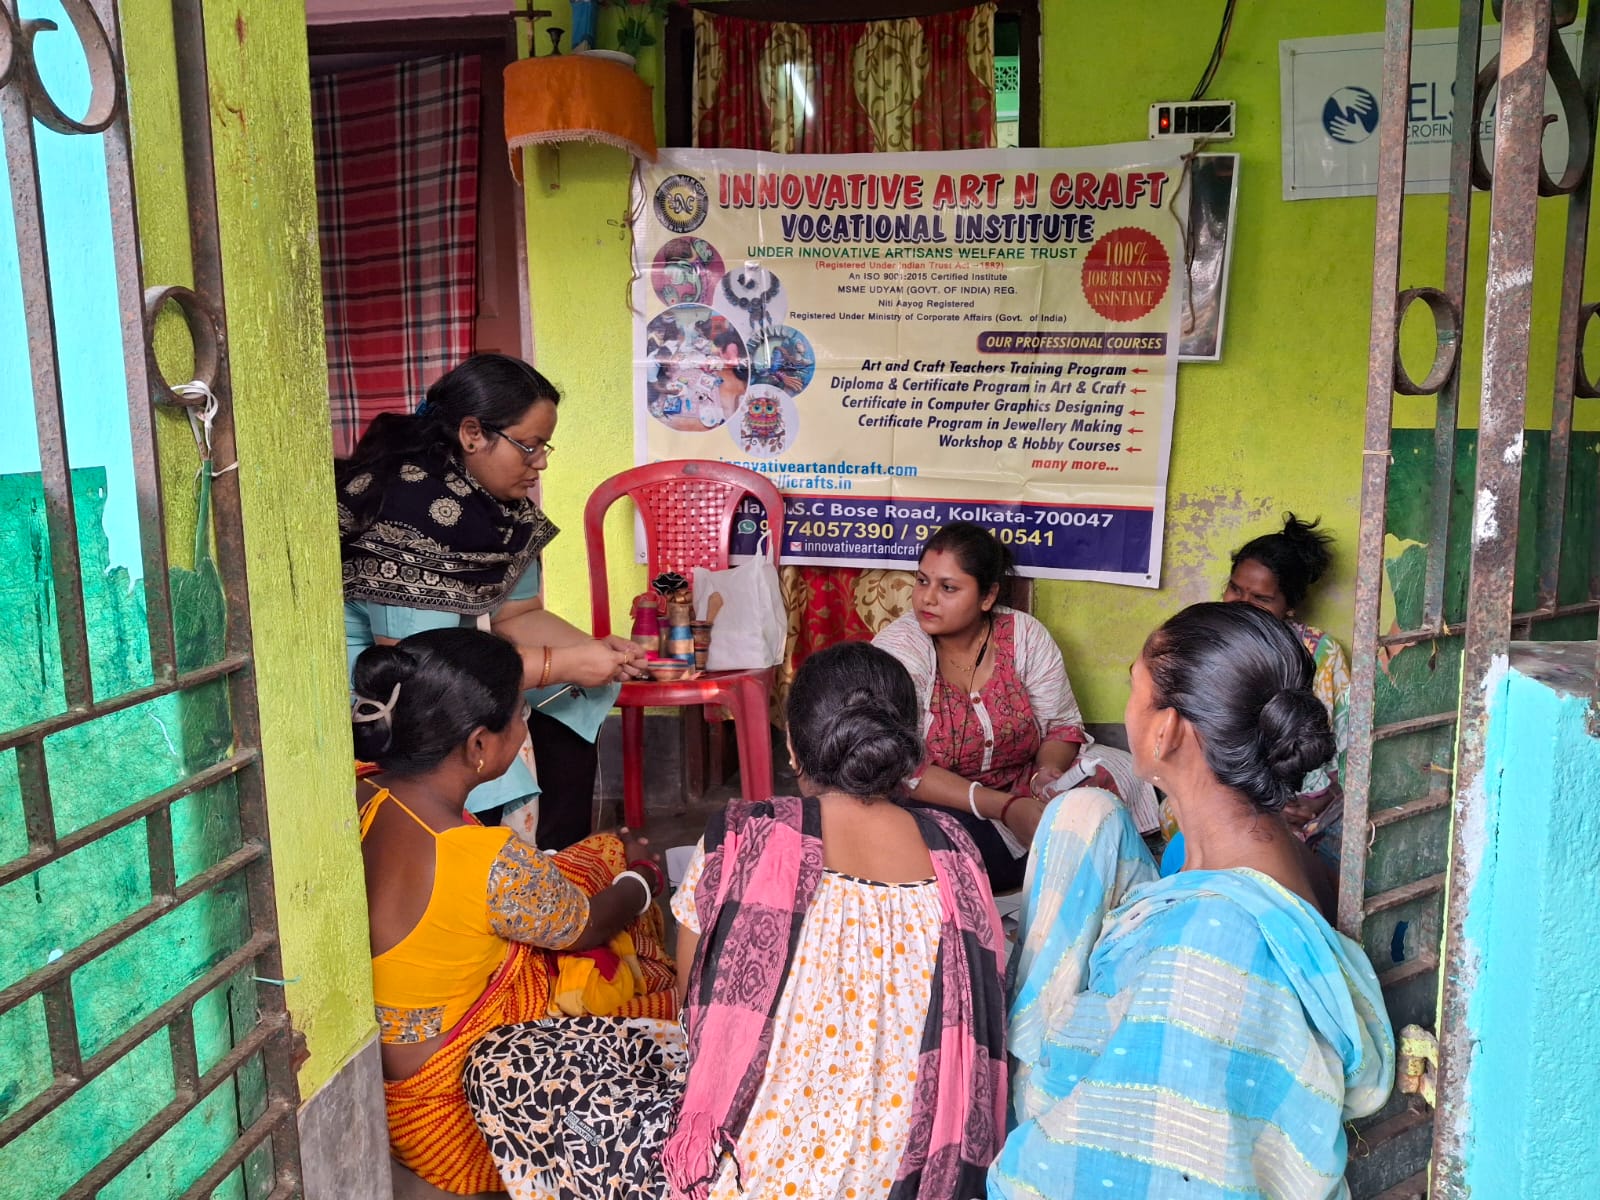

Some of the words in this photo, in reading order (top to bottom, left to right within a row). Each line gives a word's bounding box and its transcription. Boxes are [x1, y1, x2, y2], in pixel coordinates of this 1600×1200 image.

[718, 172, 924, 210] INNOVATIVE
[932, 172, 1004, 209] ART
[1013, 172, 1038, 209] N
[1049, 171, 1169, 210] CRAFT
[781, 213, 947, 244] VOCATIONAL
[954, 212, 1095, 244] INSTITUTE
[747, 246, 793, 258] UNDER
[799, 247, 880, 258] INNOVATIVE
[884, 247, 953, 259] ARTISANS
[958, 247, 1025, 259] WELFARE
[1030, 247, 1078, 259] TRUST
[1103, 241, 1150, 267] 100%
[815, 260, 866, 270] (Registered
[869, 261, 896, 269] Under
[849, 272, 860, 280] An
[863, 272, 880, 280] ISO
[930, 272, 969, 281] Certified
[971, 272, 1008, 281] Institute
[1087, 270, 1163, 288] JOB/BUSINESS
[869, 286, 904, 294] UDYAM
[906, 286, 941, 295] (GOVT.
[943, 286, 957, 294] OF
[960, 286, 991, 296] INDIA)
[993, 286, 1018, 295] REG.
[1094, 290, 1154, 306] ASSISTANCE
[896, 300, 923, 309] Aayog
[926, 300, 975, 309] Registered
[789, 311, 836, 320] Registered
[838, 312, 865, 320] Under
[868, 312, 901, 322] Ministry
[904, 313, 914, 321] of
[916, 313, 960, 322] Corporate
[963, 313, 993, 321] Affairs
[995, 313, 1023, 323] (Govt.
[1029, 313, 1038, 321] of
[1041, 313, 1067, 323] India)
[986, 335, 1013, 348] OUR
[1015, 336, 1103, 349] PROFESSIONAL
[1106, 337, 1163, 350] COURSES
[861, 359, 882, 372] Art
[885, 359, 910, 372] and
[913, 360, 945, 373] Craft
[949, 360, 1005, 373] Teachers
[1010, 361, 1063, 377] Training
[1067, 361, 1127, 377] Program
[831, 376, 884, 392] Diploma
[888, 377, 898, 390] &
[902, 377, 969, 392] Certificate
[973, 379, 1030, 395] Program
[1034, 380, 1046, 393] in
[1051, 380, 1072, 394] Art
[1075, 380, 1086, 394] &
[1091, 380, 1126, 395] Craft
[842, 395, 907, 409] Certificate
[911, 396, 923, 409] in
[927, 397, 990, 413] Computer
[994, 398, 1050, 414] Graphics
[1055, 399, 1124, 416] Designing
[858, 414, 923, 428] Certificate
[927, 415, 983, 431] Program
[987, 417, 999, 430] in
[1003, 418, 1067, 434] Jewellery
[1071, 419, 1123, 436] Making
[939, 434, 1003, 451] Workshop
[1007, 436, 1018, 449] &
[1022, 437, 1064, 454] Hobby
[1068, 438, 1121, 452] Courses
[1032, 459, 1068, 472] many
[1071, 460, 1119, 471] more...
[830, 503, 879, 518] Bose
[885, 504, 942, 523] Road,
[949, 506, 1114, 528] Kolkata-700047
[760, 520, 894, 540] 974057390
